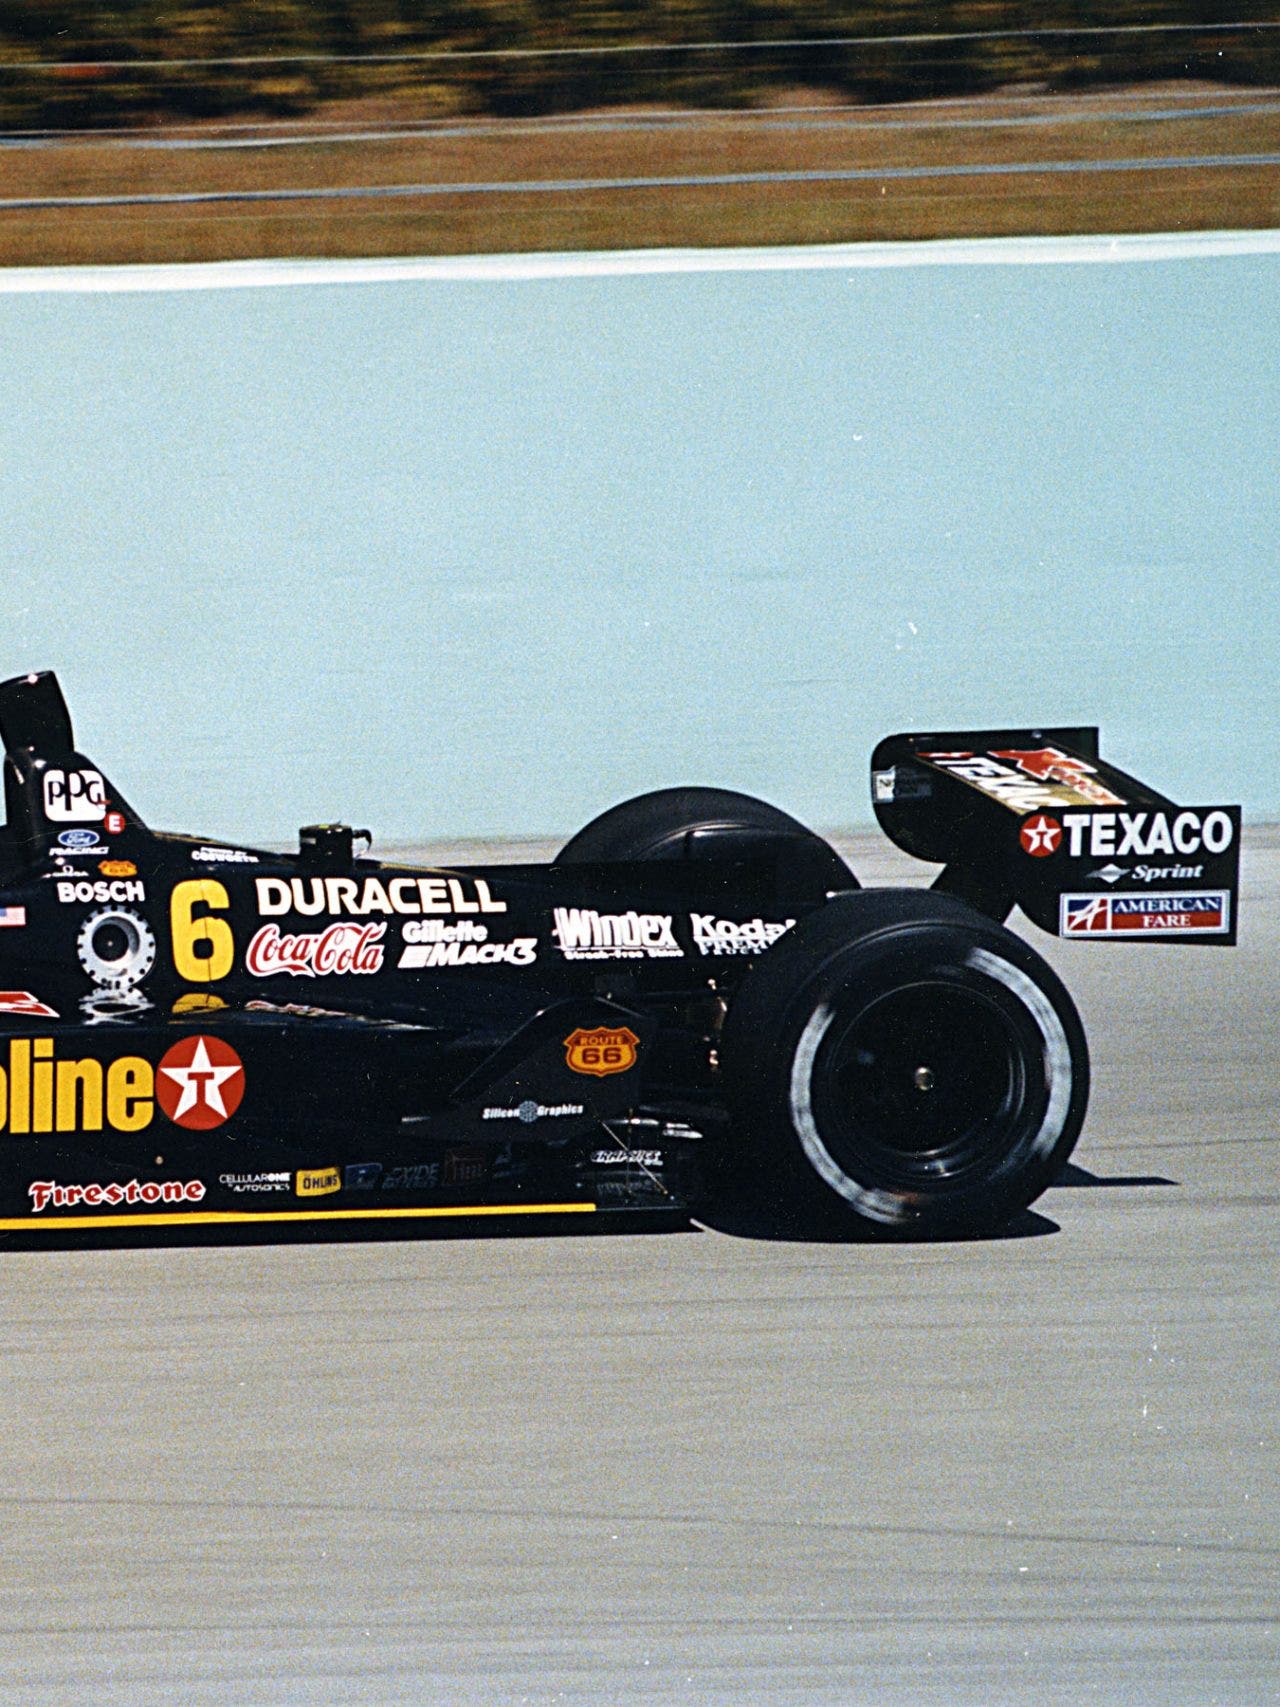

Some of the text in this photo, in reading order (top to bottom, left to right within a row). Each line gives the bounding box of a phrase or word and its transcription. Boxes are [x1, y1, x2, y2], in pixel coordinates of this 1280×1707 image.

[933, 757, 1071, 810] TEXAC
[1062, 811, 1234, 857] TEXACO
[1131, 864, 1205, 882] Sprint
[57, 880, 146, 903] BOSCH
[254, 877, 508, 916] DURACELL
[1114, 898, 1221, 913] AMERICAN
[170, 878, 235, 983] 6
[401, 920, 488, 943] Gillette
[554, 908, 679, 948] Windex
[1143, 914, 1192, 927] FARE
[247, 922, 387, 978] Coca-Cola
[579, 1035, 623, 1046] ROUTE
[581, 1047, 622, 1064] 66
[482, 1103, 584, 1120] Silicon Graphics
[219, 1172, 292, 1184] CELLULARONE
[28, 1178, 207, 1212] Firestone
